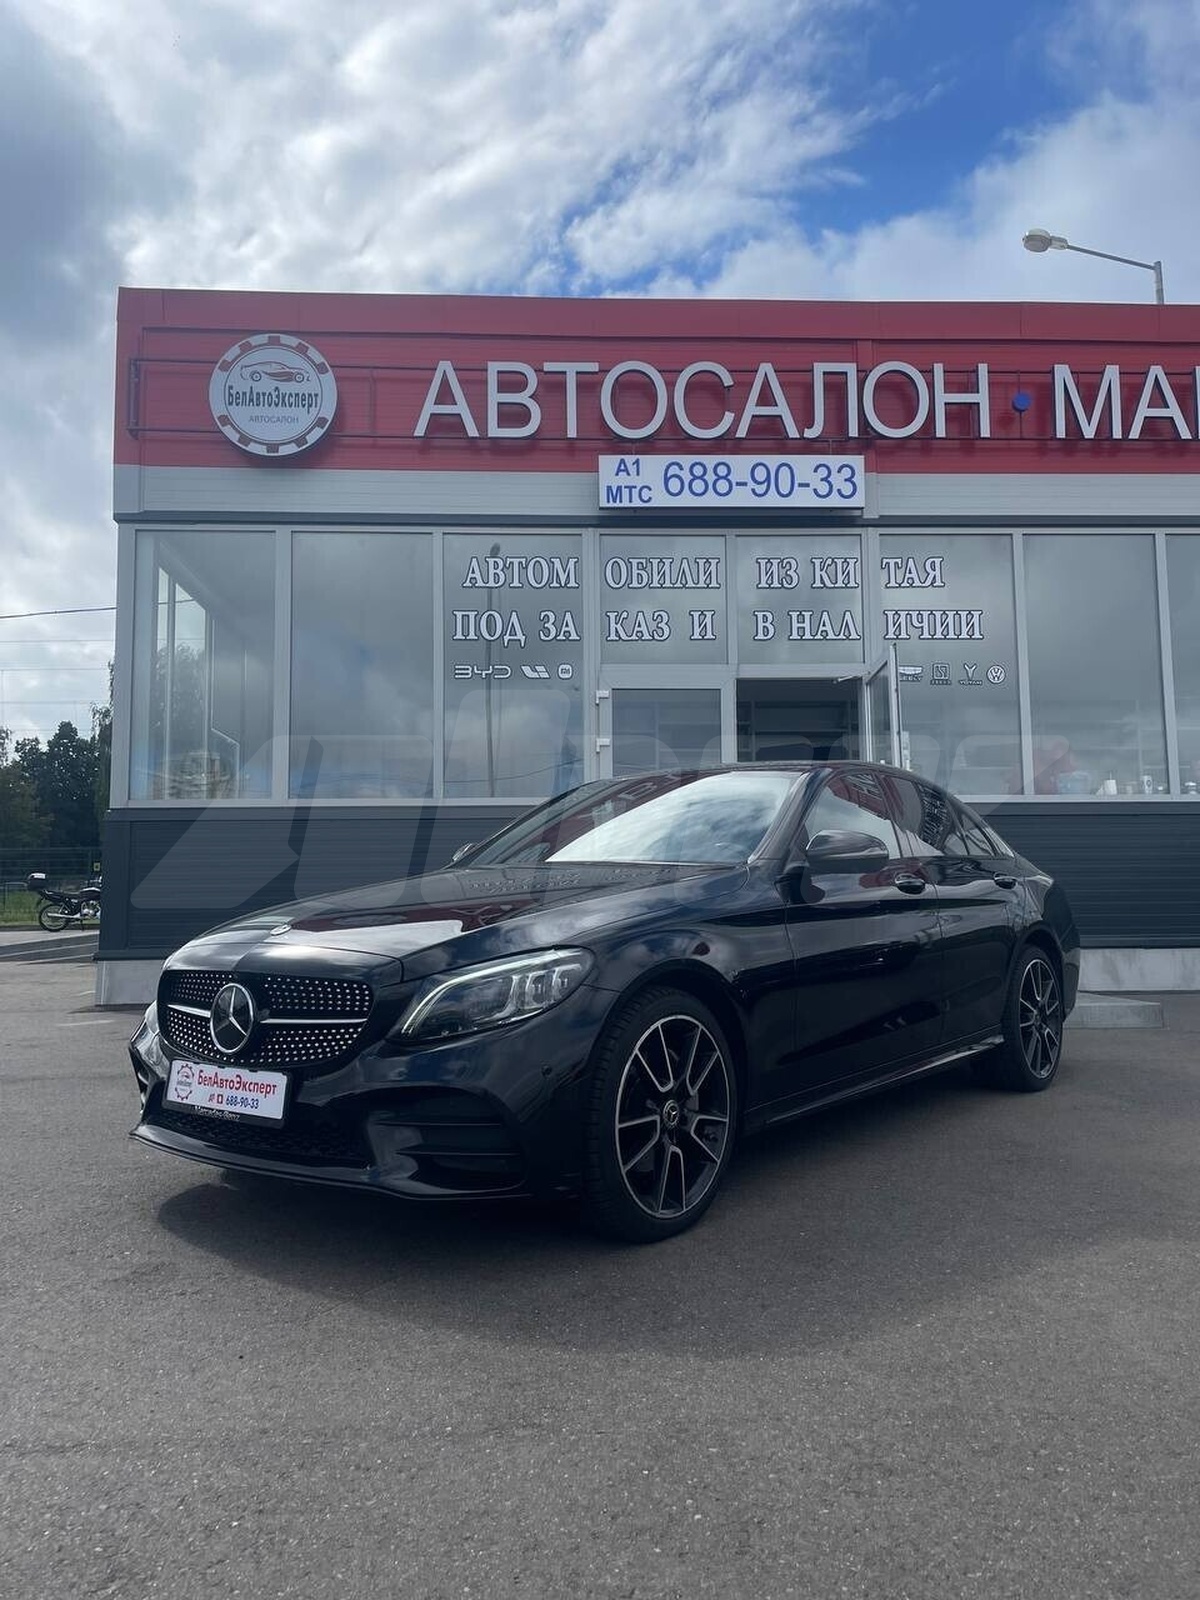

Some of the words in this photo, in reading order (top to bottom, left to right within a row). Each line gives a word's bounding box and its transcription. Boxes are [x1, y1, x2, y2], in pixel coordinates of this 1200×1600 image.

[227, 384, 319, 415] БелАвтоЭксперт
[412, 361, 991, 440] АВТОСАЛОН
[1054, 364, 1200, 439] МА
[248, 415, 299, 424] АВТОСАЛОН
[663, 461, 858, 499] 688-90-33
[756, 557, 800, 589] ИЗ
[452, 610, 527, 649] ПОД
[689, 610, 717, 641] И
[753, 610, 776, 640] В
[454, 665, 512, 679] BYD
[197, 1069, 277, 1098] БелАвтоЭксперт
[226, 1095, 260, 1109] 688-90-33
